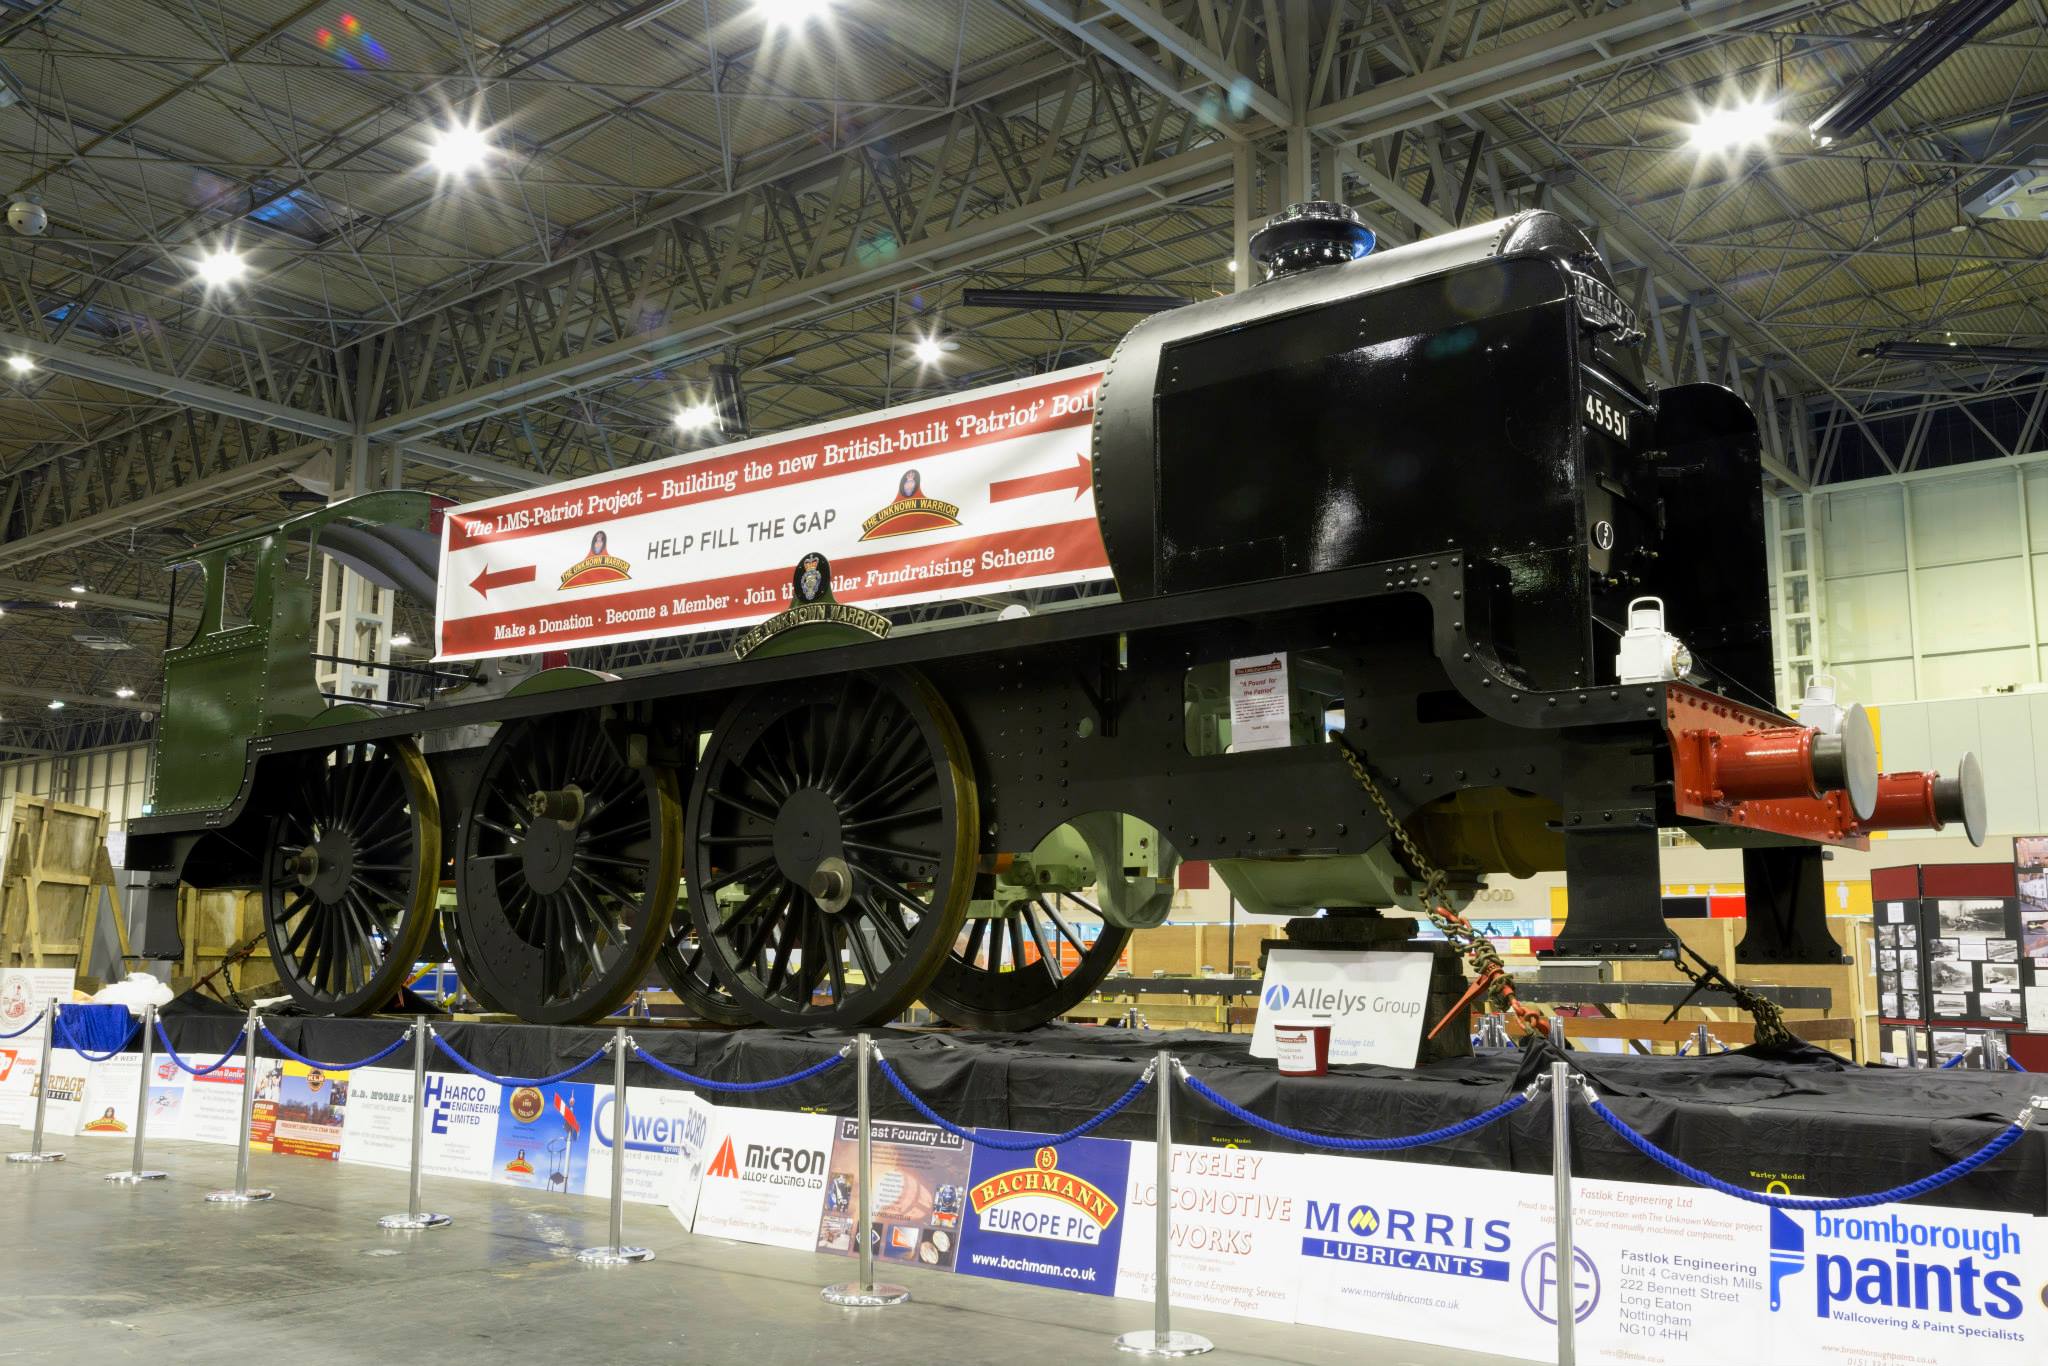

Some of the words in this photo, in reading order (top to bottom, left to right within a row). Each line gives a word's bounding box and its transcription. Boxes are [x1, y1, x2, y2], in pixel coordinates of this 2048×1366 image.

[1577, 275, 1633, 326] ATRIOT
[1586, 394, 1627, 440] 45551
[464, 519, 492, 538] The
[496, 504, 583, 534] LMS-Patriot
[587, 489, 643, 516] Project
[661, 471, 737, 499] Building
[744, 461, 774, 483] the
[777, 453, 817, 478] new
[823, 425, 950, 467] British-built
[863, 514, 878, 531] THE
[878, 499, 918, 522] UNKNOWN
[920, 498, 958, 516] WARRIOR
[647, 535, 694, 560] HELP
[699, 528, 740, 552] FILL
[747, 517, 785, 543] THE
[792, 508, 837, 535] GAP
[1602, 523, 1609, 537] 5
[561, 566, 573, 580] THE
[572, 556, 602, 576] UNKNOWN
[602, 555, 630, 571] WARRIOR
[494, 624, 525, 640] Make
[528, 625, 537, 637] a
[539, 615, 593, 635] Donation
[605, 605, 656, 625] Become
[660, 606, 668, 617] a
[673, 594, 730, 617] Member
[743, 587, 776, 606] Join
[865, 556, 975, 588] Fundraising
[981, 546, 1056, 570] Scheme
[741, 627, 763, 655] THE
[765, 605, 826, 636] UNKNOWN
[830, 604, 886, 636] WARRIOR
[1480, 889, 1514, 902] OOD
[1292, 987, 1366, 1016] Allelys
[1373, 997, 1421, 1017] Group
[30, 1072, 86, 1102] HRITAGE
[444, 1086, 486, 1102] HARCO
[450, 1114, 480, 1126] LIMITED
[451, 1101, 501, 1114] ENGINEERING
[594, 1092, 685, 1147] Owen
[685, 1107, 707, 1149] BORO
[847, 1124, 888, 1138] Prast
[892, 1128, 938, 1146] Foundry
[1171, 1151, 1263, 1180] TYSELEY
[1750, 1171, 1776, 1180] Warley
[742, 1171, 767, 1182] ALLOY
[769, 1174, 805, 1188] CASTINGS
[807, 1180, 823, 1190] LTD
[981, 1174, 1107, 1217] BACHMANN
[1581, 1188, 1613, 1201] Fastlok
[1617, 1191, 1673, 1207] Engineering
[1676, 1197, 1693, 1208] Ltd
[989, 1208, 1060, 1235] EUROPE
[1305, 1200, 1511, 1253] MORRIS
[1518, 1200, 1538, 1211] Proud
[1540, 1203, 1548, 1211] to
[1588, 1209, 1630, 1221] conjunction
[1632, 1212, 1648, 1221] with
[1650, 1213, 1663, 1222] The
[1665, 1214, 1701, 1225] Unknown
[1703, 1218, 1733, 1229] Warrior
[1736, 1221, 1763, 1233] project
[1595, 1220, 1609, 1229] and
[1611, 1221, 1644, 1234] manually
[1647, 1225, 1684, 1237] machined
[1169, 1223, 1252, 1255] WORKS
[1816, 1209, 2021, 1260] bromborough
[972, 1253, 1096, 1281] www.bachmann.co.uk
[1323, 1241, 1484, 1277] LUBRICANTS
[1621, 1250, 1669, 1265] Fastlok
[1674, 1255, 1757, 1276] Engineering
[1119, 1268, 1148, 1282] Providing
[1194, 1279, 1209, 1289] and
[1211, 1281, 1254, 1298] Engineering
[1256, 1287, 1286, 1300] Services
[1620, 1279, 1643, 1291] 222
[1648, 1281, 1696, 1298] Bennett
[1700, 1287, 1739, 1303] Street
[1621, 1264, 1645, 1277] Unit
[1648, 1267, 1656, 1278] 4
[1661, 1268, 1728, 1287] Cavendish
[1733, 1276, 1763, 1290] Mills
[1816, 1249, 2024, 1320] paints
[1341, 1286, 1459, 1310] www.morrislubricants.co.uk
[1620, 1293, 1651, 1309] Long
[1656, 1297, 1692, 1312] Eaton
[1620, 1307, 1692, 1327] Nottingham
[1833, 1311, 1908, 1330] Wallcovering
[1911, 1320, 1920, 1329] &
[1923, 1321, 1954, 1333] Paint
[1958, 1325, 2025, 1342] Specialists
[1619, 1323, 1656, 1338] NG10
[1659, 1328, 1688, 1342] 4HH
